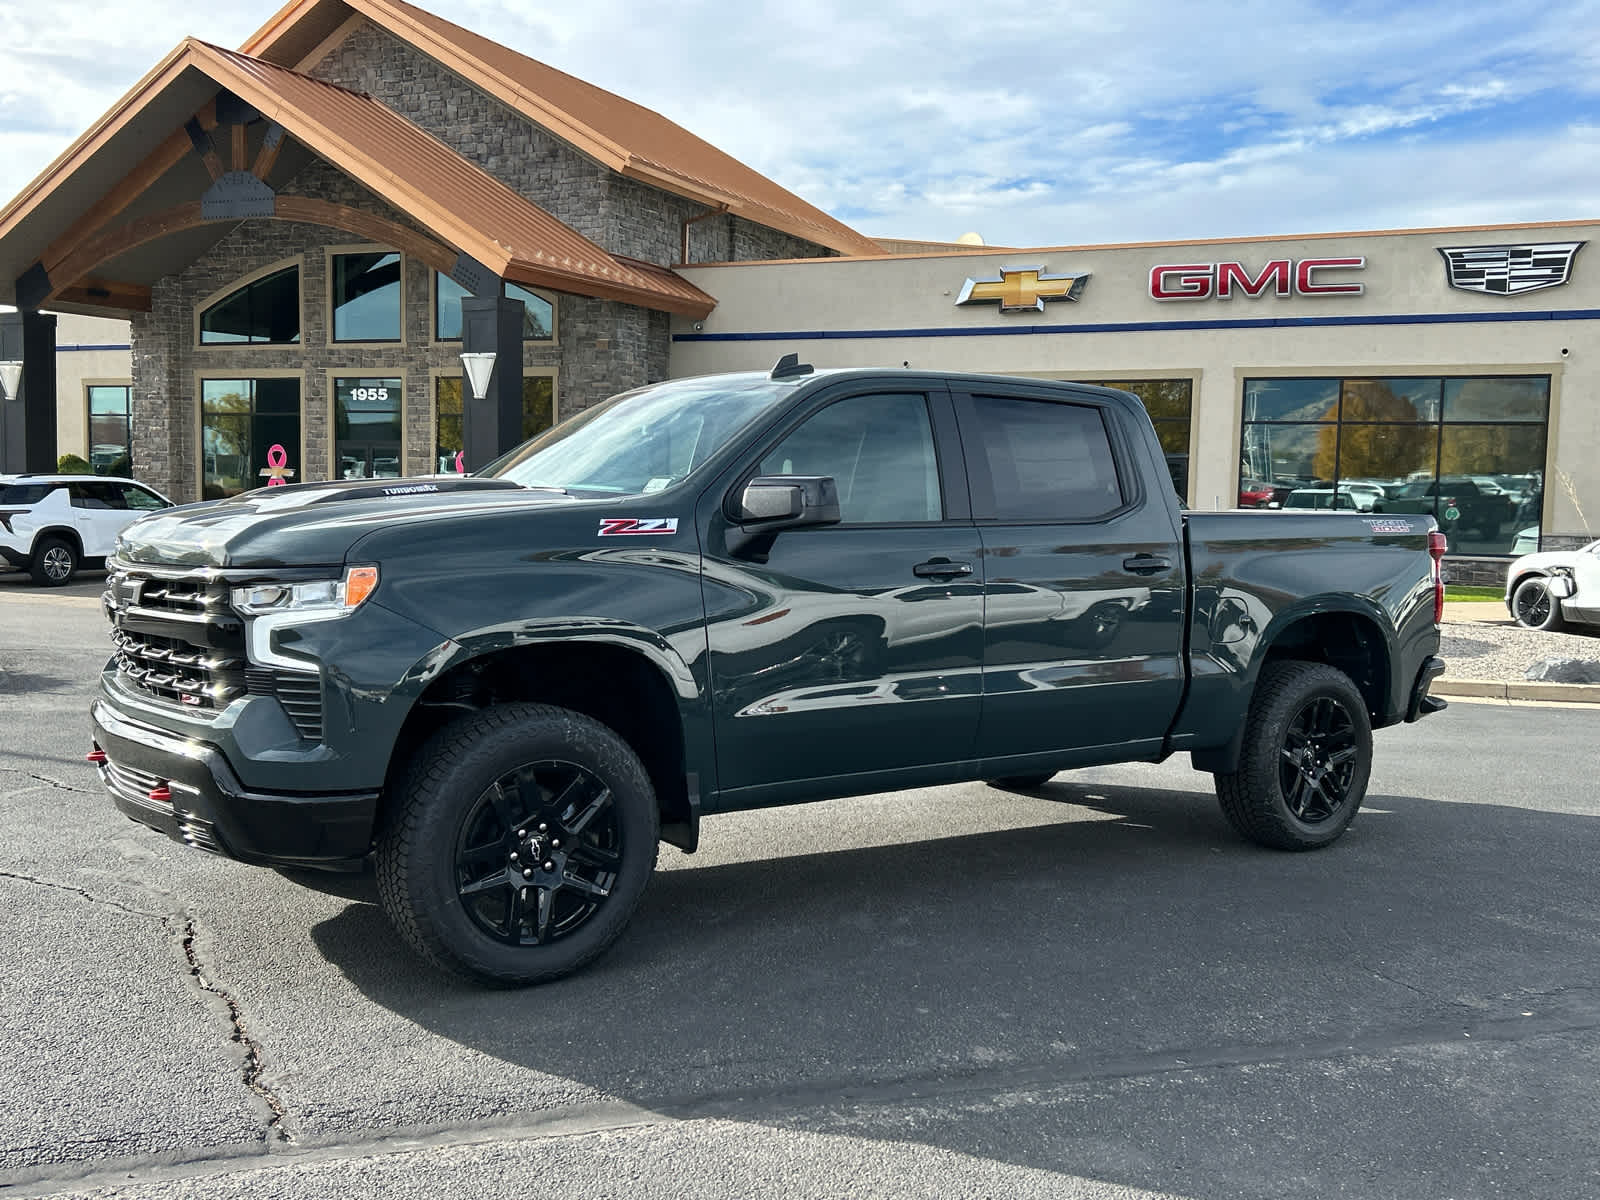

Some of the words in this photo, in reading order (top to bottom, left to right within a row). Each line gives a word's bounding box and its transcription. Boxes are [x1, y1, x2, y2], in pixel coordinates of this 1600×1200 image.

[1149, 256, 1366, 301] GMC
[350, 388, 388, 400] 1955
[598, 518, 679, 537] Z71
